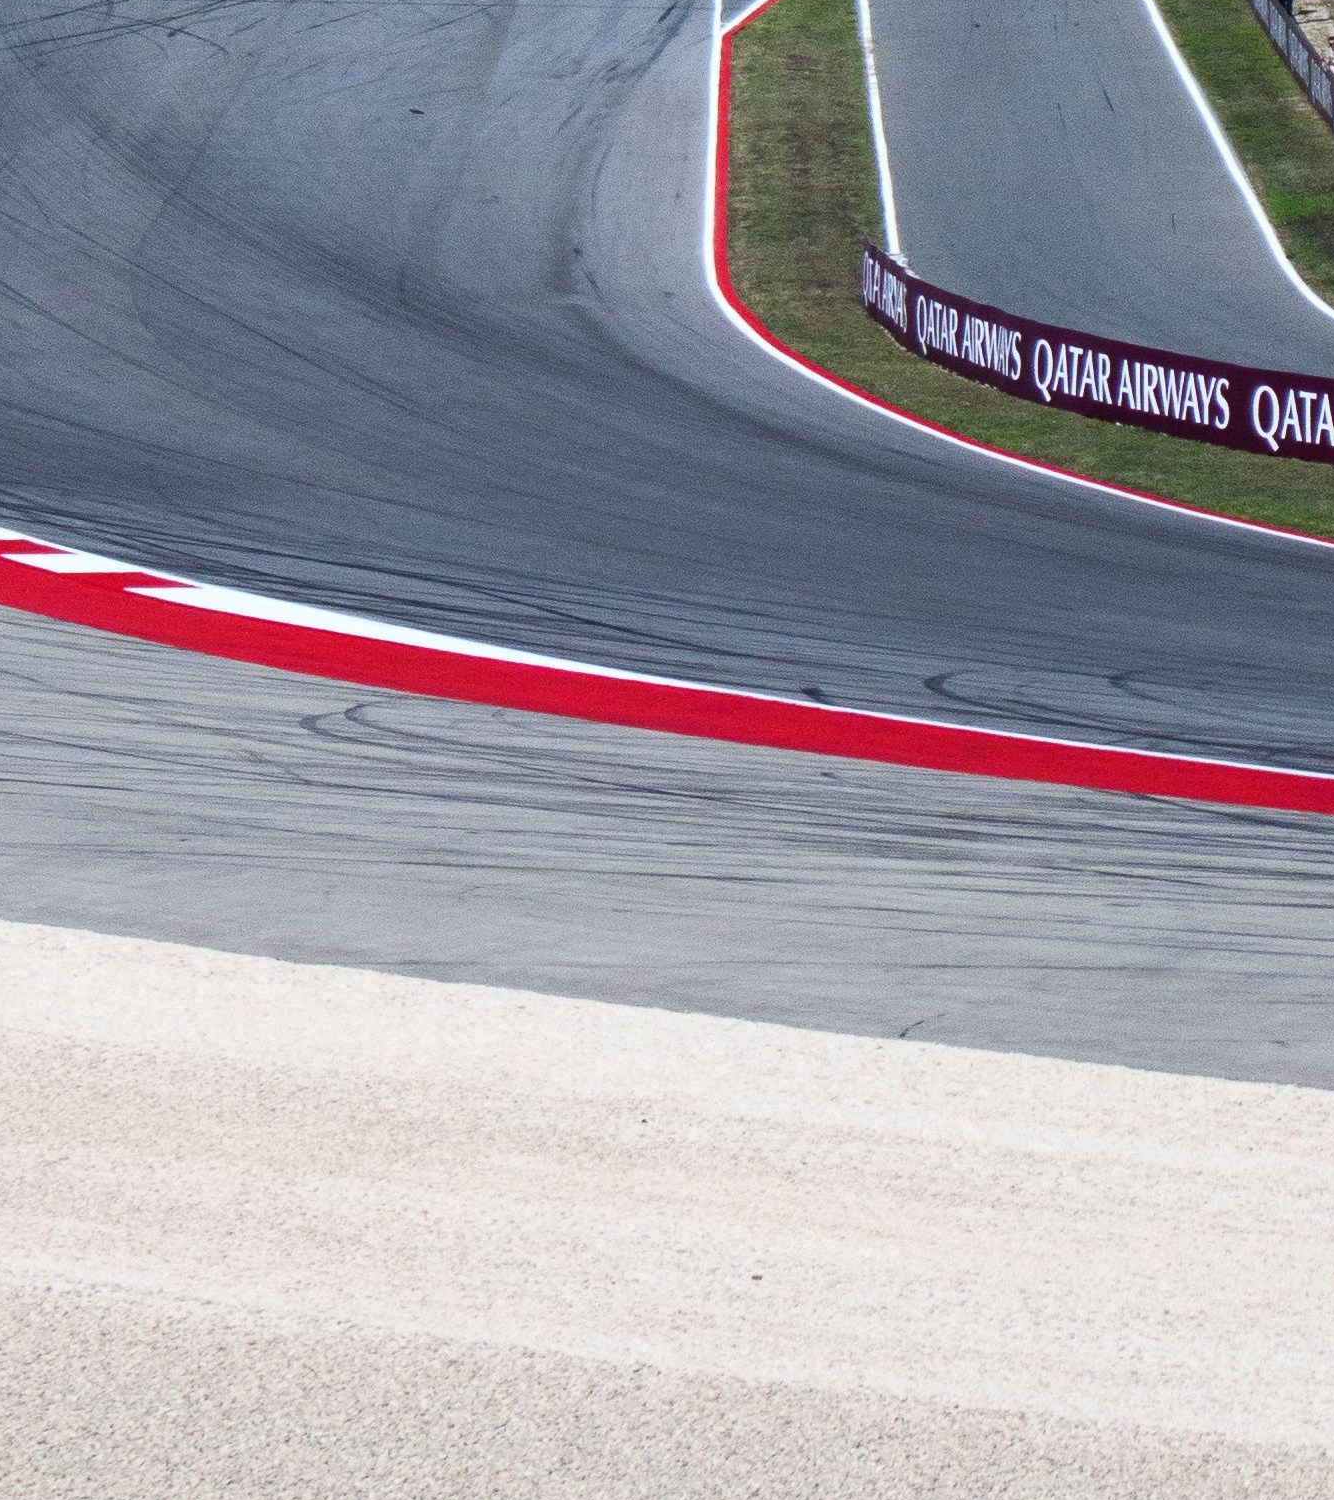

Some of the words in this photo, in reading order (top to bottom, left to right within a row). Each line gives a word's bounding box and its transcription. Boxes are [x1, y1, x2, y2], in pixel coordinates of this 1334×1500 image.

[916, 294, 958, 357] QATAR
[962, 315, 1022, 381] AIRWAYS
[1033, 338, 1112, 403] QATAR
[1118, 363, 1230, 430] AIRWAYS
